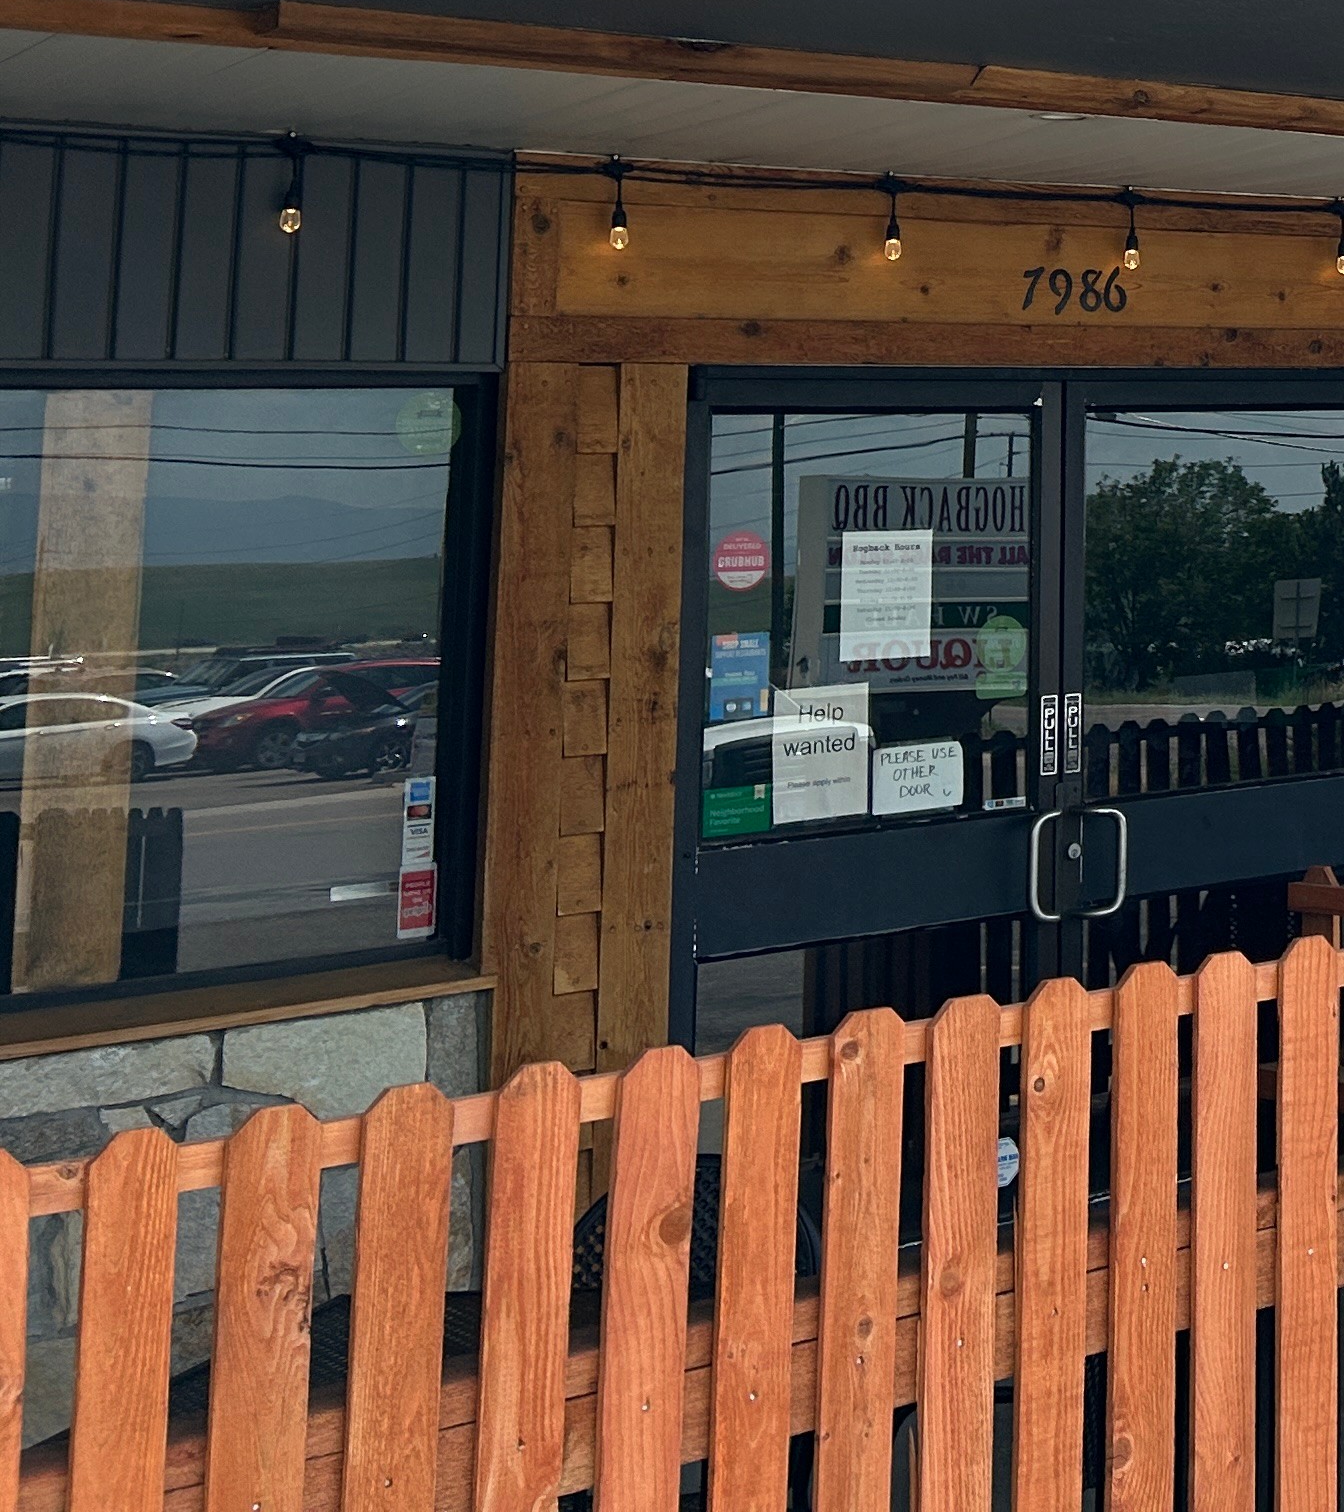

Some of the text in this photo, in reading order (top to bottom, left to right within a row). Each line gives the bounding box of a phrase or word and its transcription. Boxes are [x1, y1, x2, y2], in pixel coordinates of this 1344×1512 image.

[853, 543, 921, 554] Hogback Hours
[718, 555, 765, 568] GRUBHUB
[799, 703, 844, 724] Help
[1044, 707, 1054, 751] PULL
[1067, 706, 1078, 748] PULL
[783, 733, 856, 756] wanted
[880, 746, 958, 766] PLEASE USE
[893, 764, 939, 781] OTHER
[900, 783, 933, 798] DOOR
[709, 805, 765, 818] Neighborhood
[410, 827, 429, 835] VISA
